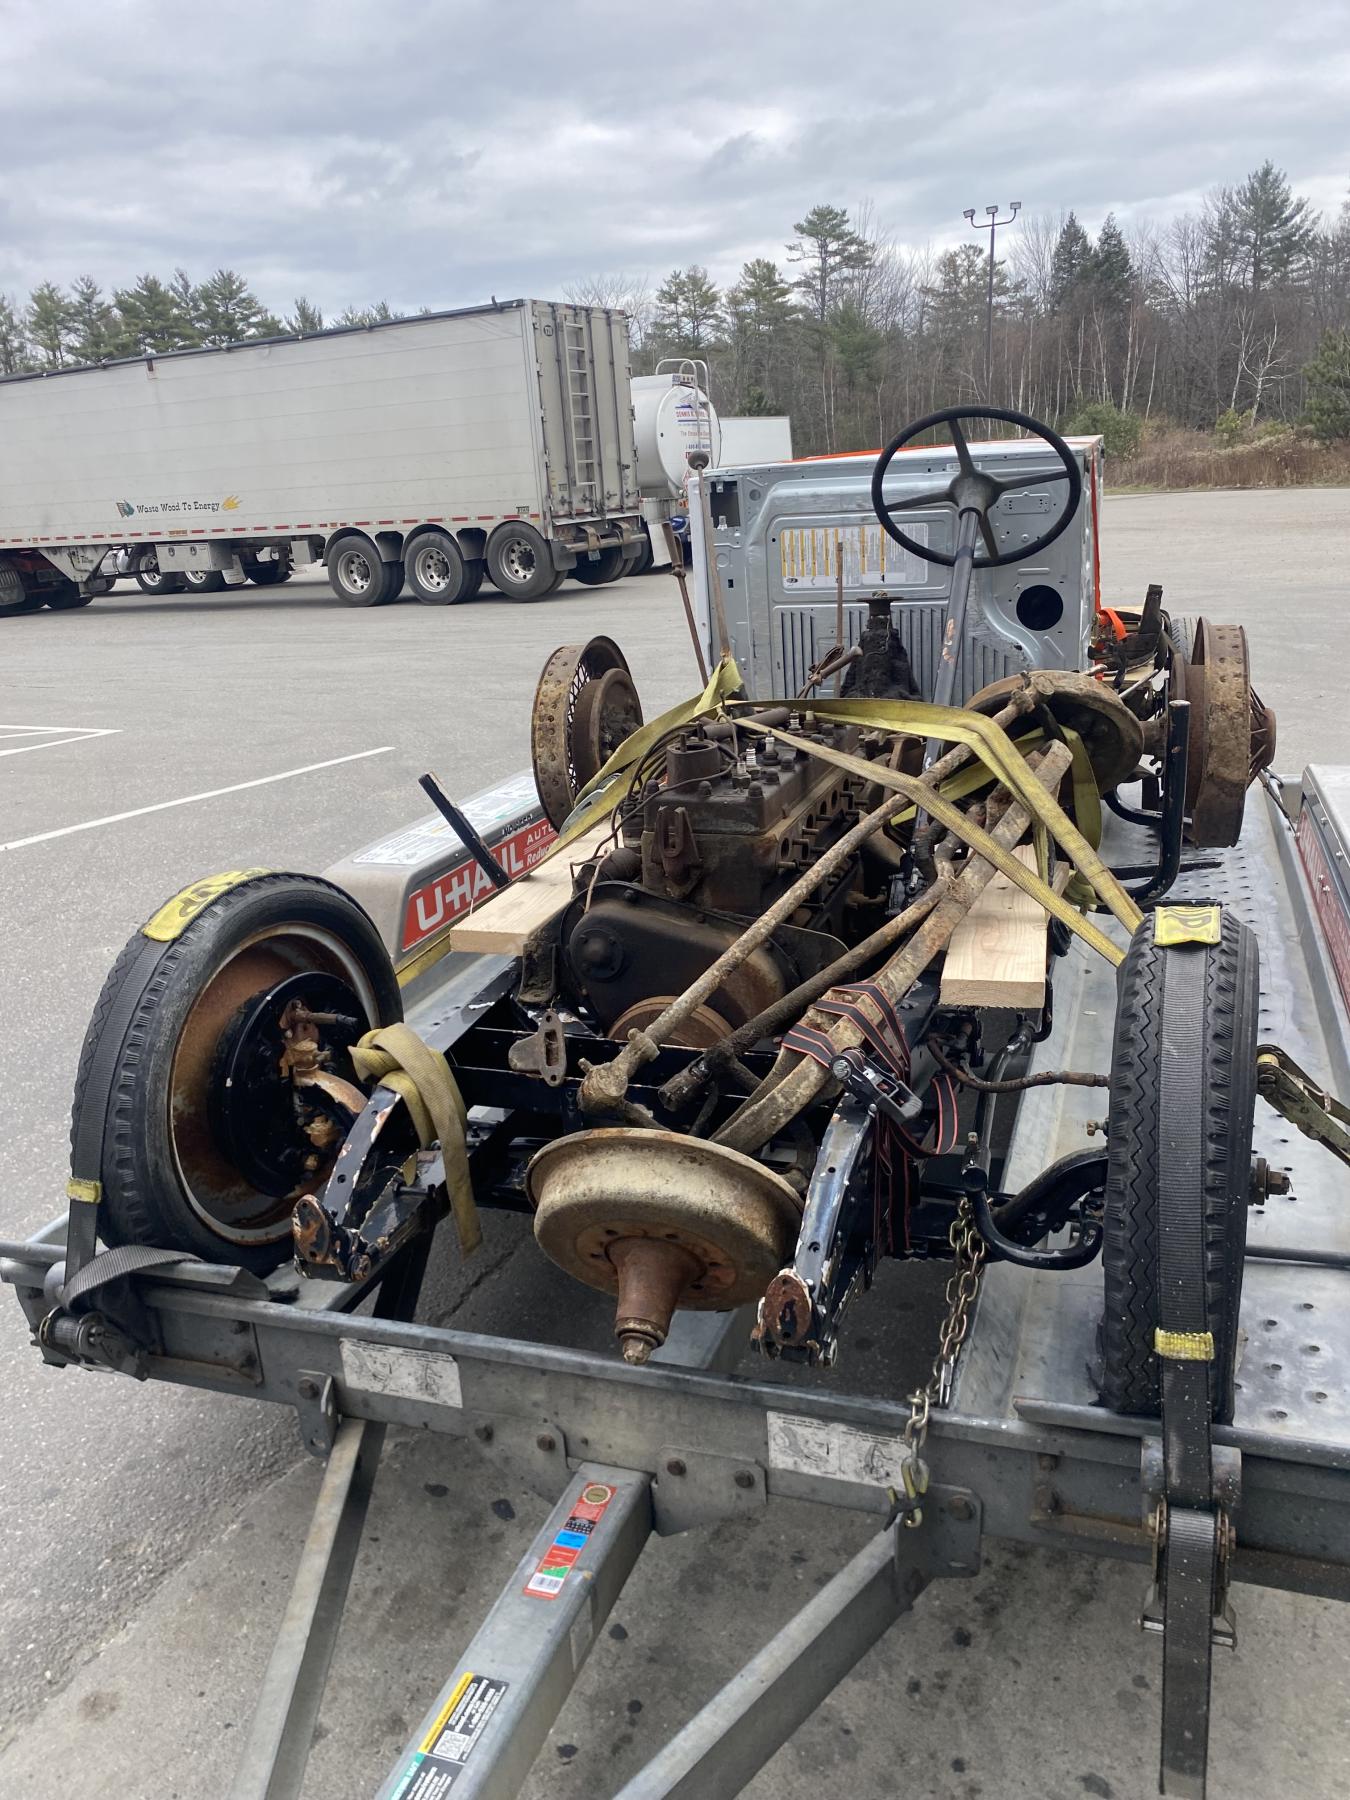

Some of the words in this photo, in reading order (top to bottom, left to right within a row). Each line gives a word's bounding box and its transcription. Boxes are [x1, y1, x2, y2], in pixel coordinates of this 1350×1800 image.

[136, 504, 159, 514] Waste
[160, 502, 180, 512] Wood
[181, 502, 192, 511] To
[193, 500, 220, 513] Energy
